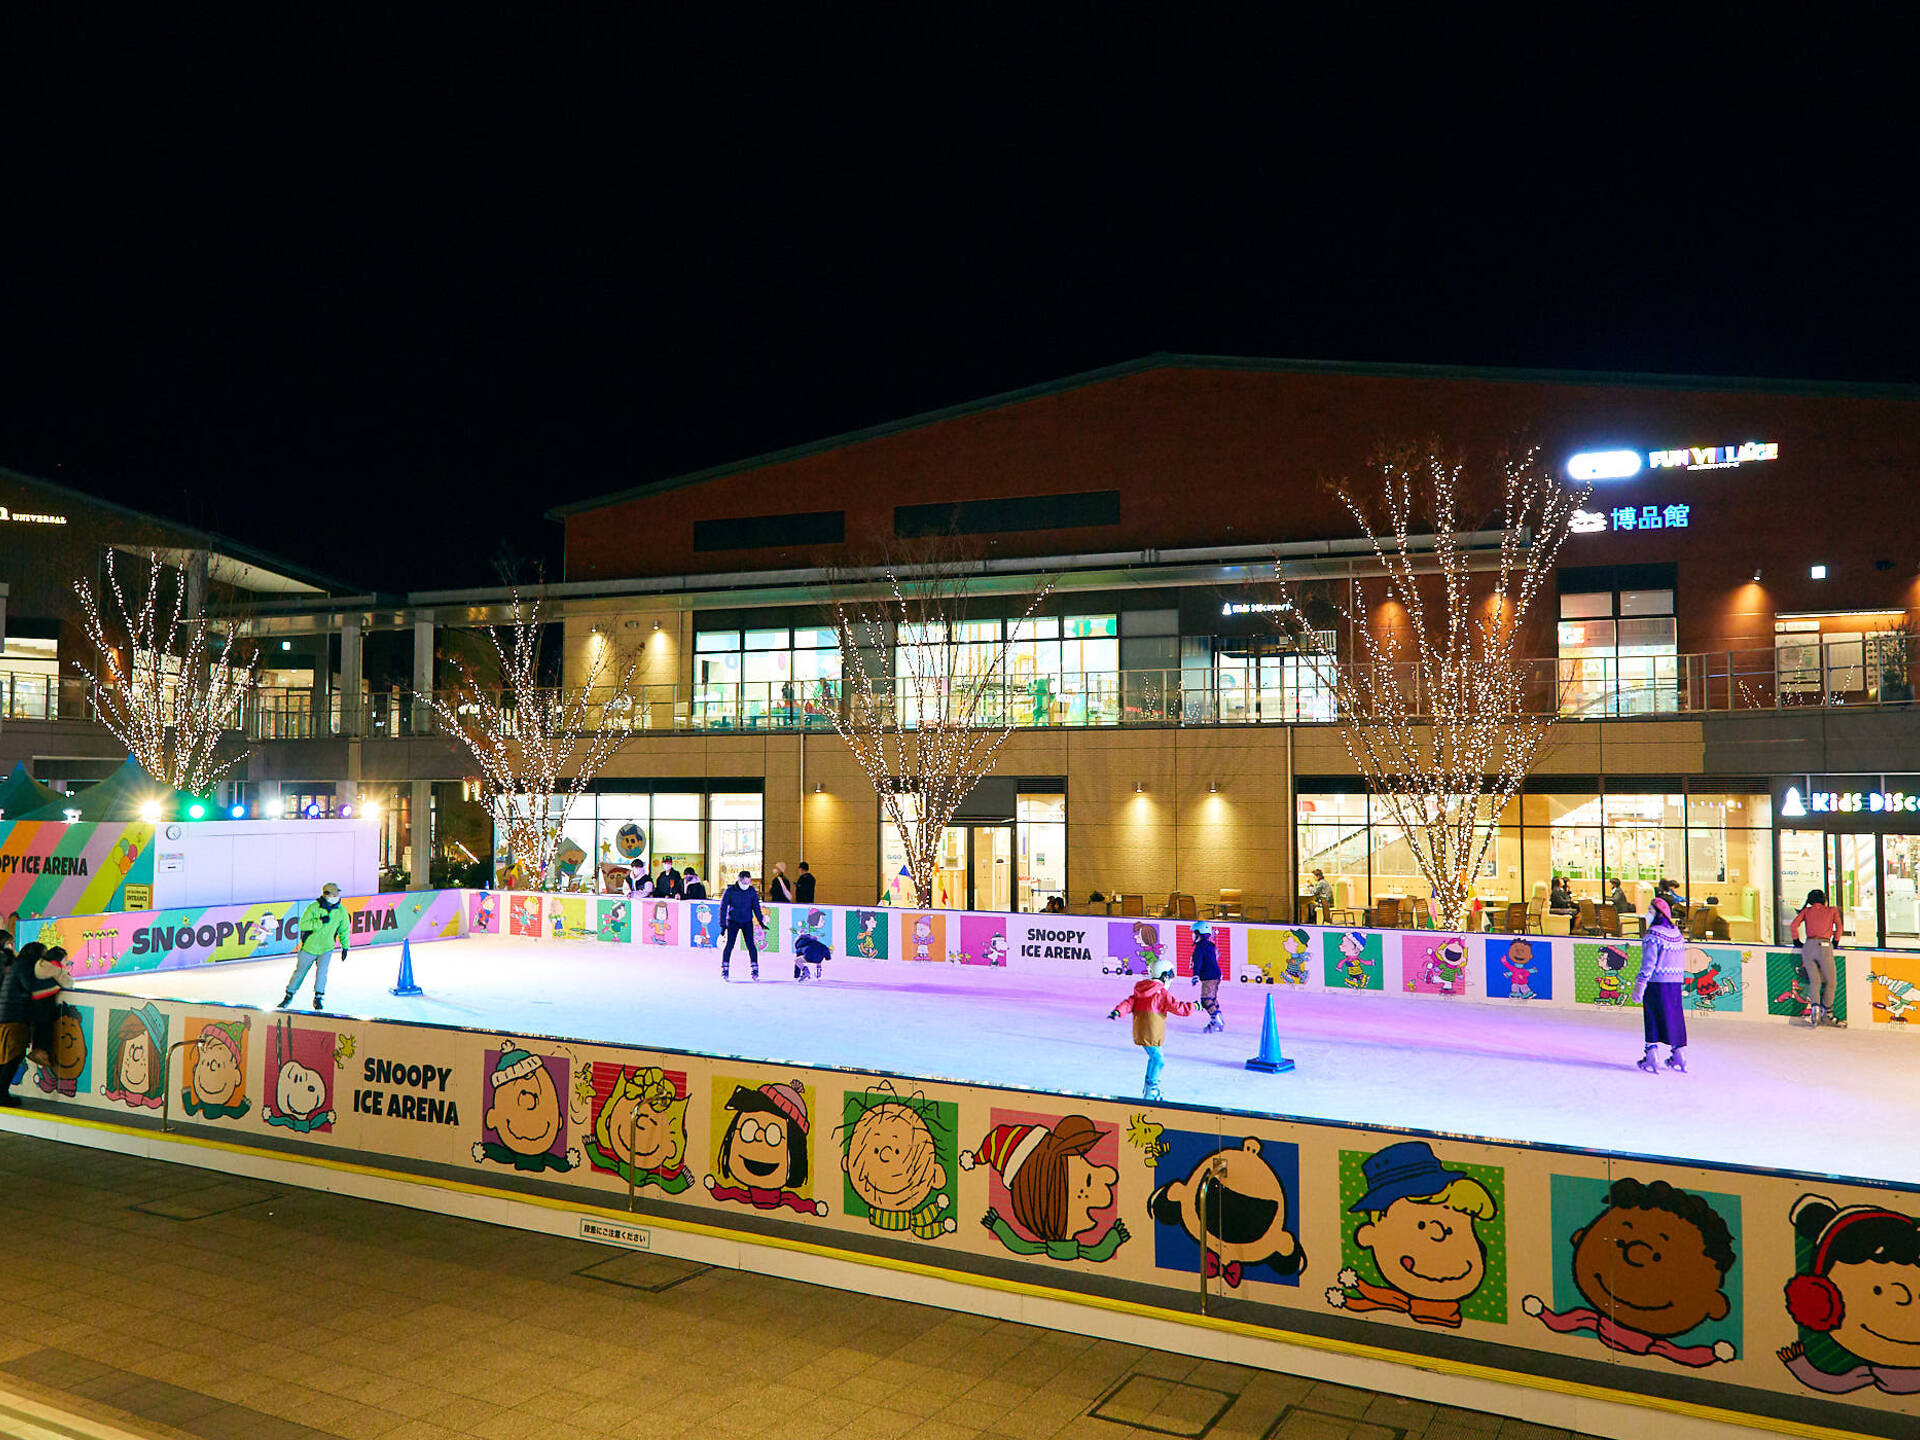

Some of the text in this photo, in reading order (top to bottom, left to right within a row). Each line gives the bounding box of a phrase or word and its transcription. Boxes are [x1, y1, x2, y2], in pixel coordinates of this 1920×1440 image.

[1609, 503, 1690, 531] 博品館
[0, 855, 88, 876] PY ICE ARENA
[131, 908, 399, 955] SNOOPY IC ENA
[1027, 928, 1086, 944] SNOOPY
[1021, 944, 1092, 960] ICE ARENA
[363, 1057, 453, 1092] SNOOPY
[353, 1089, 460, 1126] ICE ARENA
